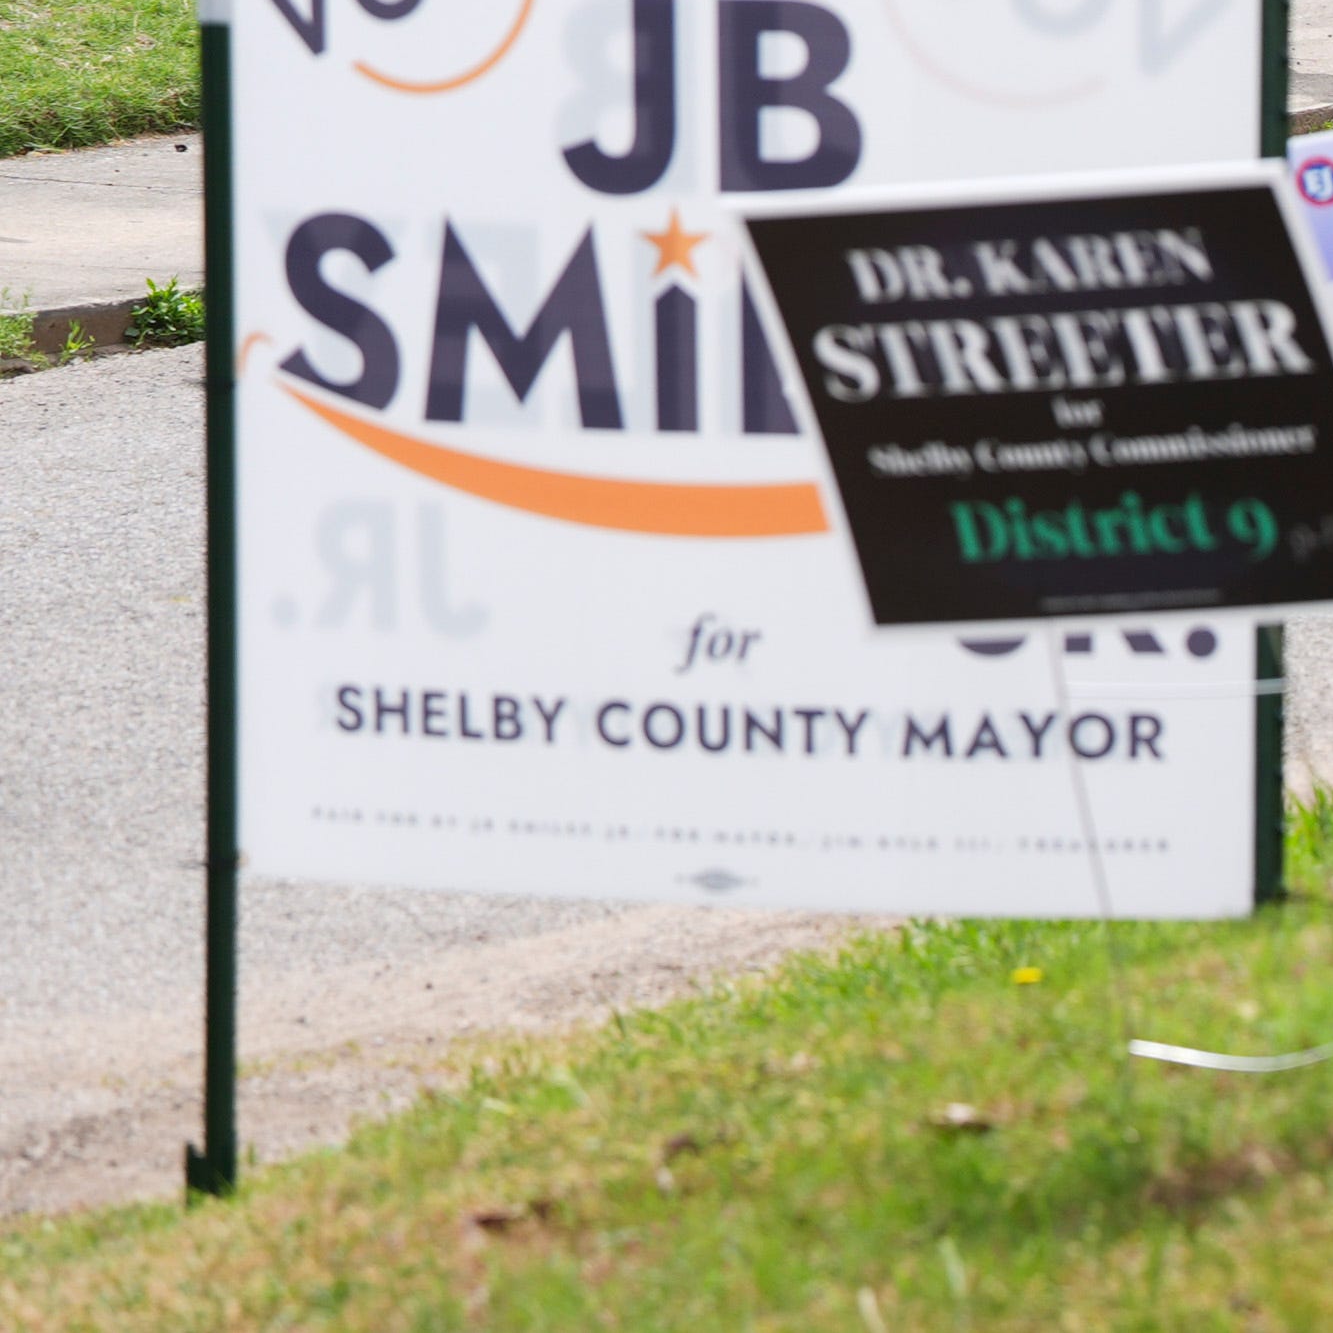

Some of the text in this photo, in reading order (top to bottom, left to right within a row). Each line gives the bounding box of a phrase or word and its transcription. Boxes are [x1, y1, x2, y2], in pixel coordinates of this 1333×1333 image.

[844, 226, 1215, 305] DR. KAREN
[810, 299, 1313, 403] STREETER
[976, 434, 1086, 472] County
[1090, 422, 1317, 466] Commissioner
[949, 491, 1215, 563] District
[1225, 498, 1279, 560] 9
[678, 612, 763, 673] for
[336, 685, 1164, 760] SHELBY COUNTY MAYOR
